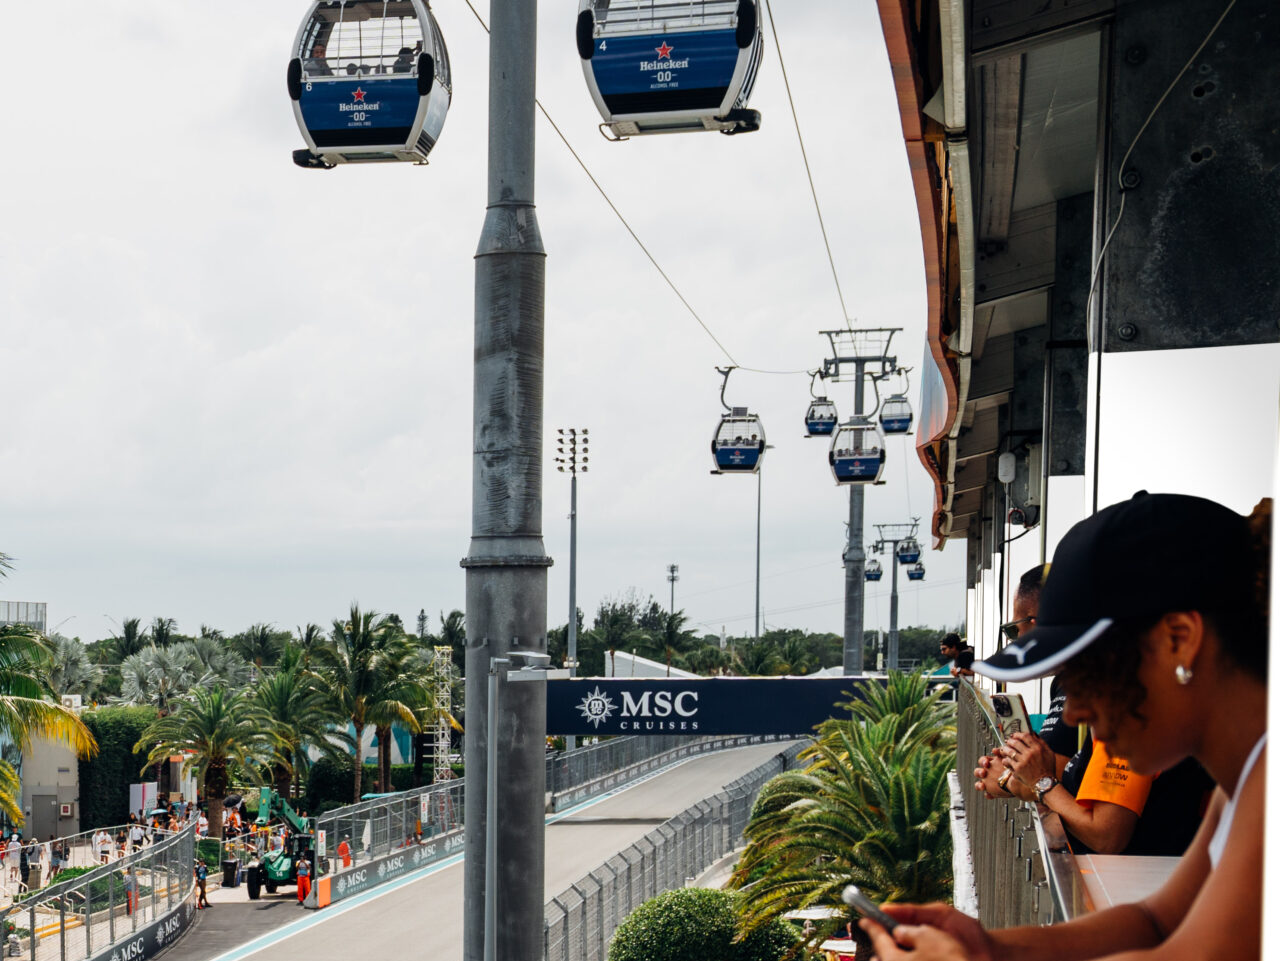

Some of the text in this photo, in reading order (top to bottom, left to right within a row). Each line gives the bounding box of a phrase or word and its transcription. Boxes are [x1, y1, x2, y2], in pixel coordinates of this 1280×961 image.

[599, 40, 607, 51] 4
[640, 59, 689, 71] Heineken
[305, 82, 312, 92] 6
[339, 102, 379, 112] Heineken
[620, 691, 698, 717] MSC
[620, 721, 699, 730] CRUISES
[421, 843, 436, 860] MSC
[387, 855, 404, 873] MSC
[347, 869, 367, 888] MSC
[165, 912, 180, 936] MSC
